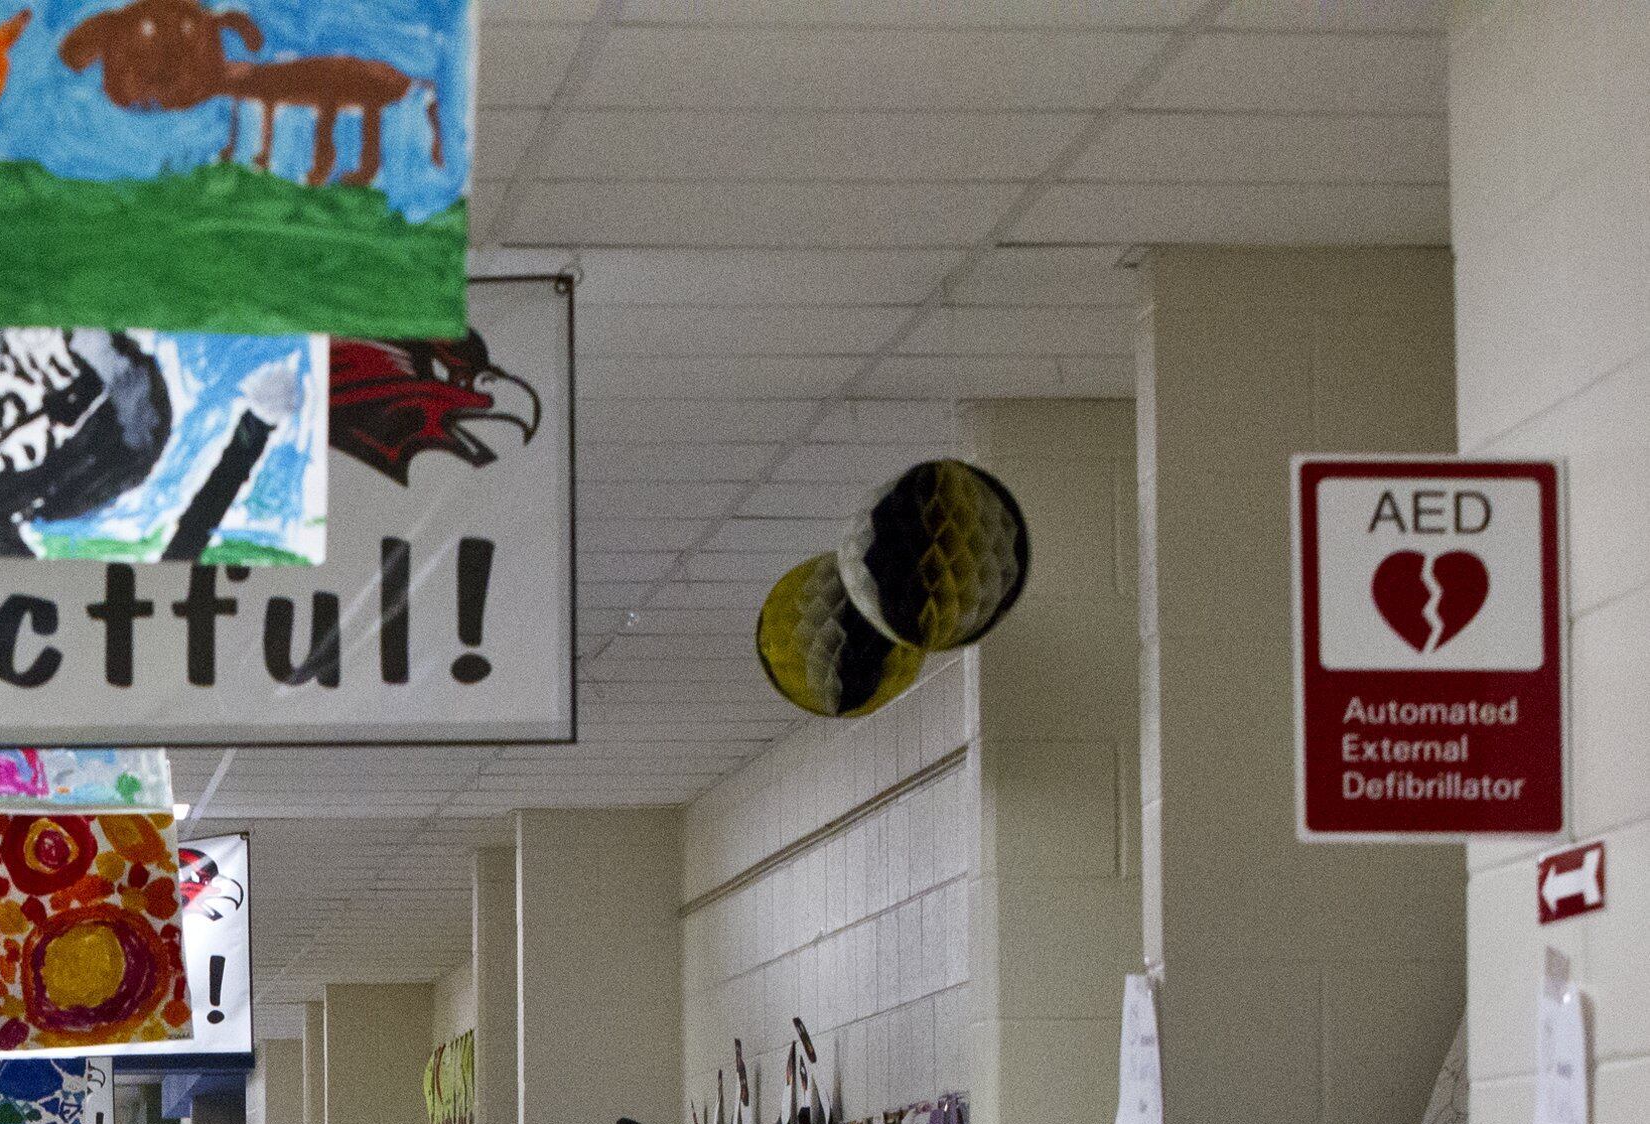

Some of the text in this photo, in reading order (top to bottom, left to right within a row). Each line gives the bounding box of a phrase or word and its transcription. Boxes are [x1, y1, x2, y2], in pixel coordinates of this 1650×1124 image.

[1368, 490, 1492, 534] AED
[1343, 697, 1519, 726] Automated
[1342, 734, 1468, 762] External
[1343, 771, 1525, 800] Defibrillator
